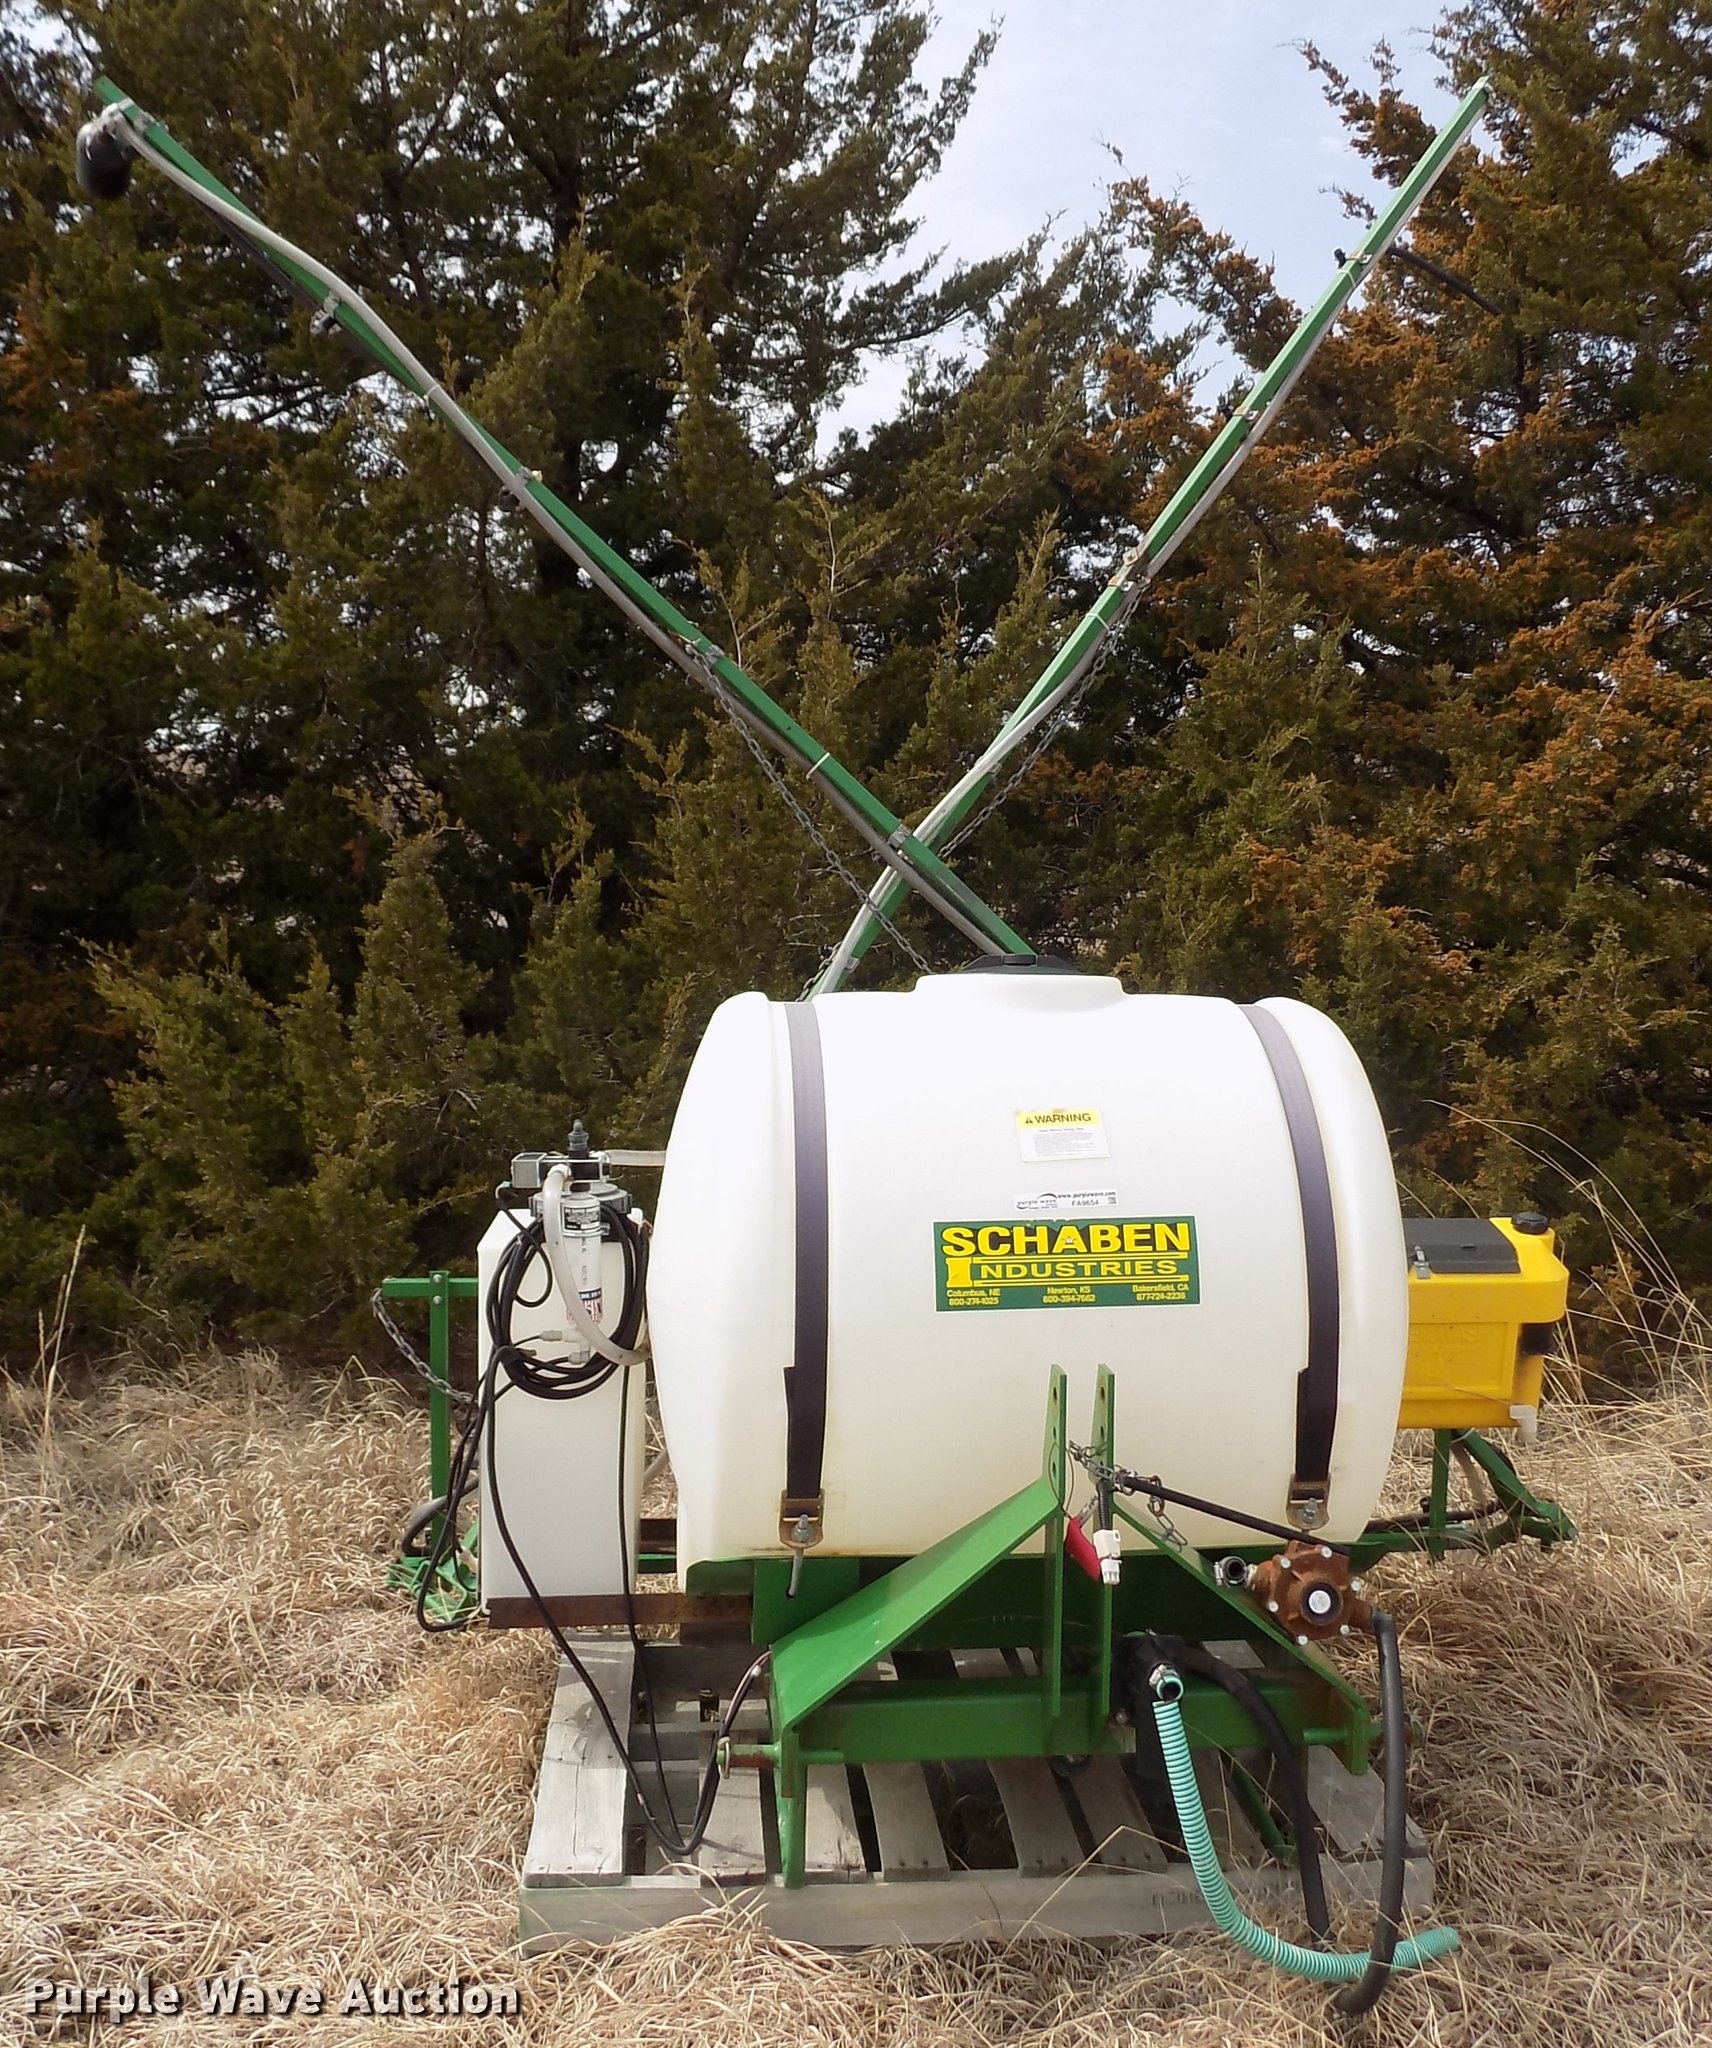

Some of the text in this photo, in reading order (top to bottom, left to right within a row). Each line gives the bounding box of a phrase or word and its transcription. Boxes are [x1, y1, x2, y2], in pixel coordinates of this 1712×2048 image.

[1034, 1112, 1092, 1124] WARNING
[1071, 1199, 1100, 1207] FA9654
[941, 1222, 1191, 1256] SCHABEN
[946, 1256, 1179, 1288] INDUSTRIES
[946, 1288, 1001, 1298] Columbus, NE
[1047, 1285, 1091, 1295] Newton, KS
[1132, 1284, 1190, 1293] Bakersfield, CA
